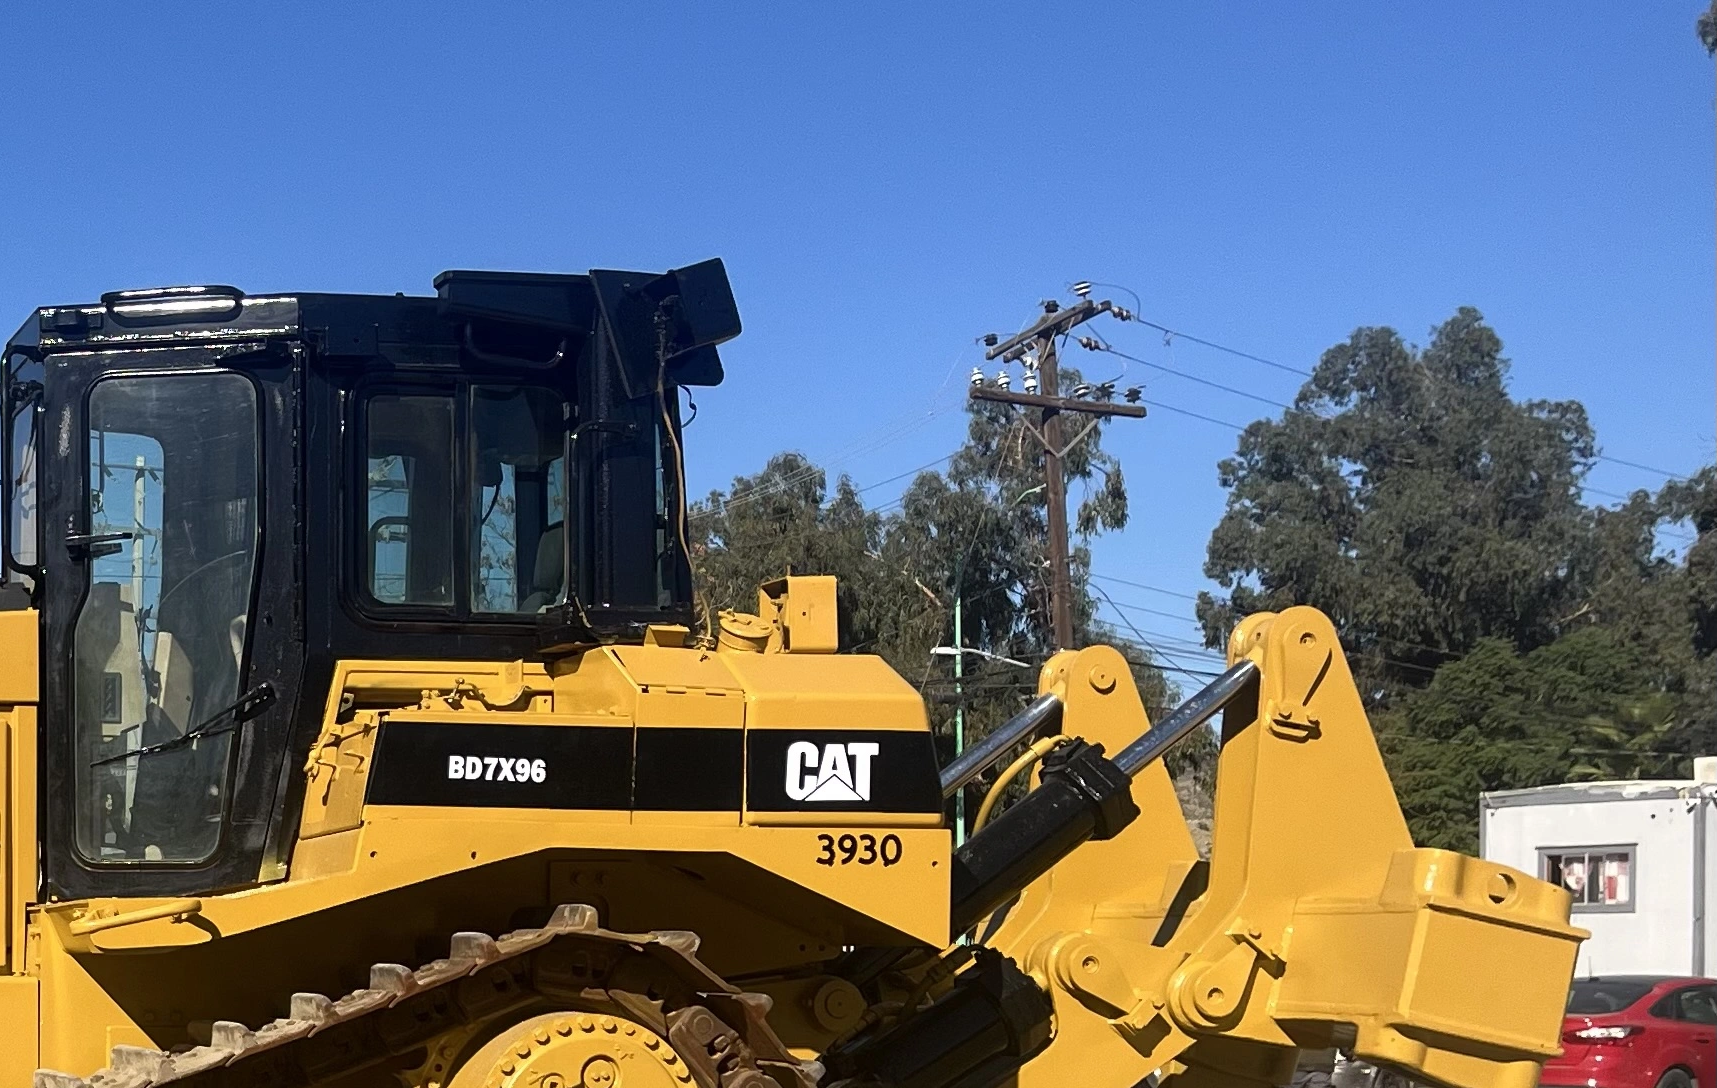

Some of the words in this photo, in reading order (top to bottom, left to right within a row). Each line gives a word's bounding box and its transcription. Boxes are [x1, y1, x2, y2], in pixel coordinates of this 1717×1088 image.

[448, 755, 547, 783] BD7X96
[785, 740, 880, 802] CAT
[815, 832, 903, 868] 3930
